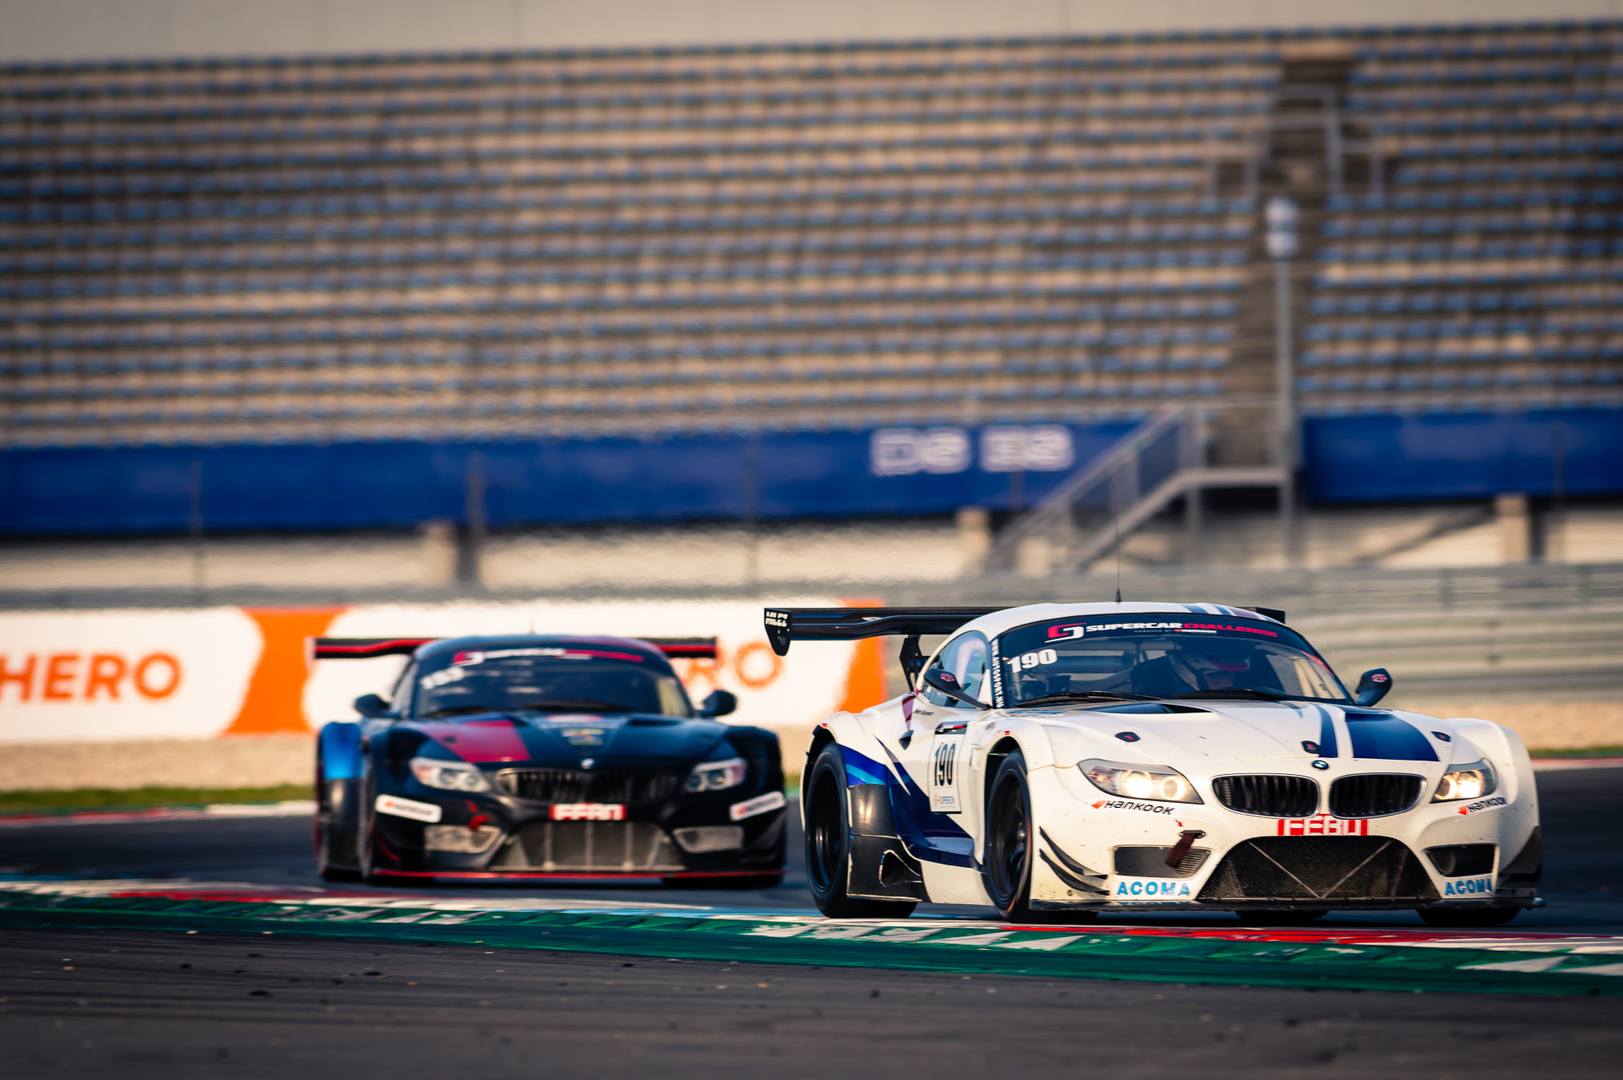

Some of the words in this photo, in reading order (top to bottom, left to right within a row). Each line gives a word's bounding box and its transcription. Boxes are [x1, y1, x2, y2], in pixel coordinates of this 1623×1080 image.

[1085, 622, 1183, 632] SUPERCAR
[1183, 622, 1279, 638] CHALLENGE
[1007, 649, 1058, 674] 190
[0, 652, 183, 703] HERO
[934, 743, 956, 786] 190
[1117, 882, 1190, 895] ACOMA
